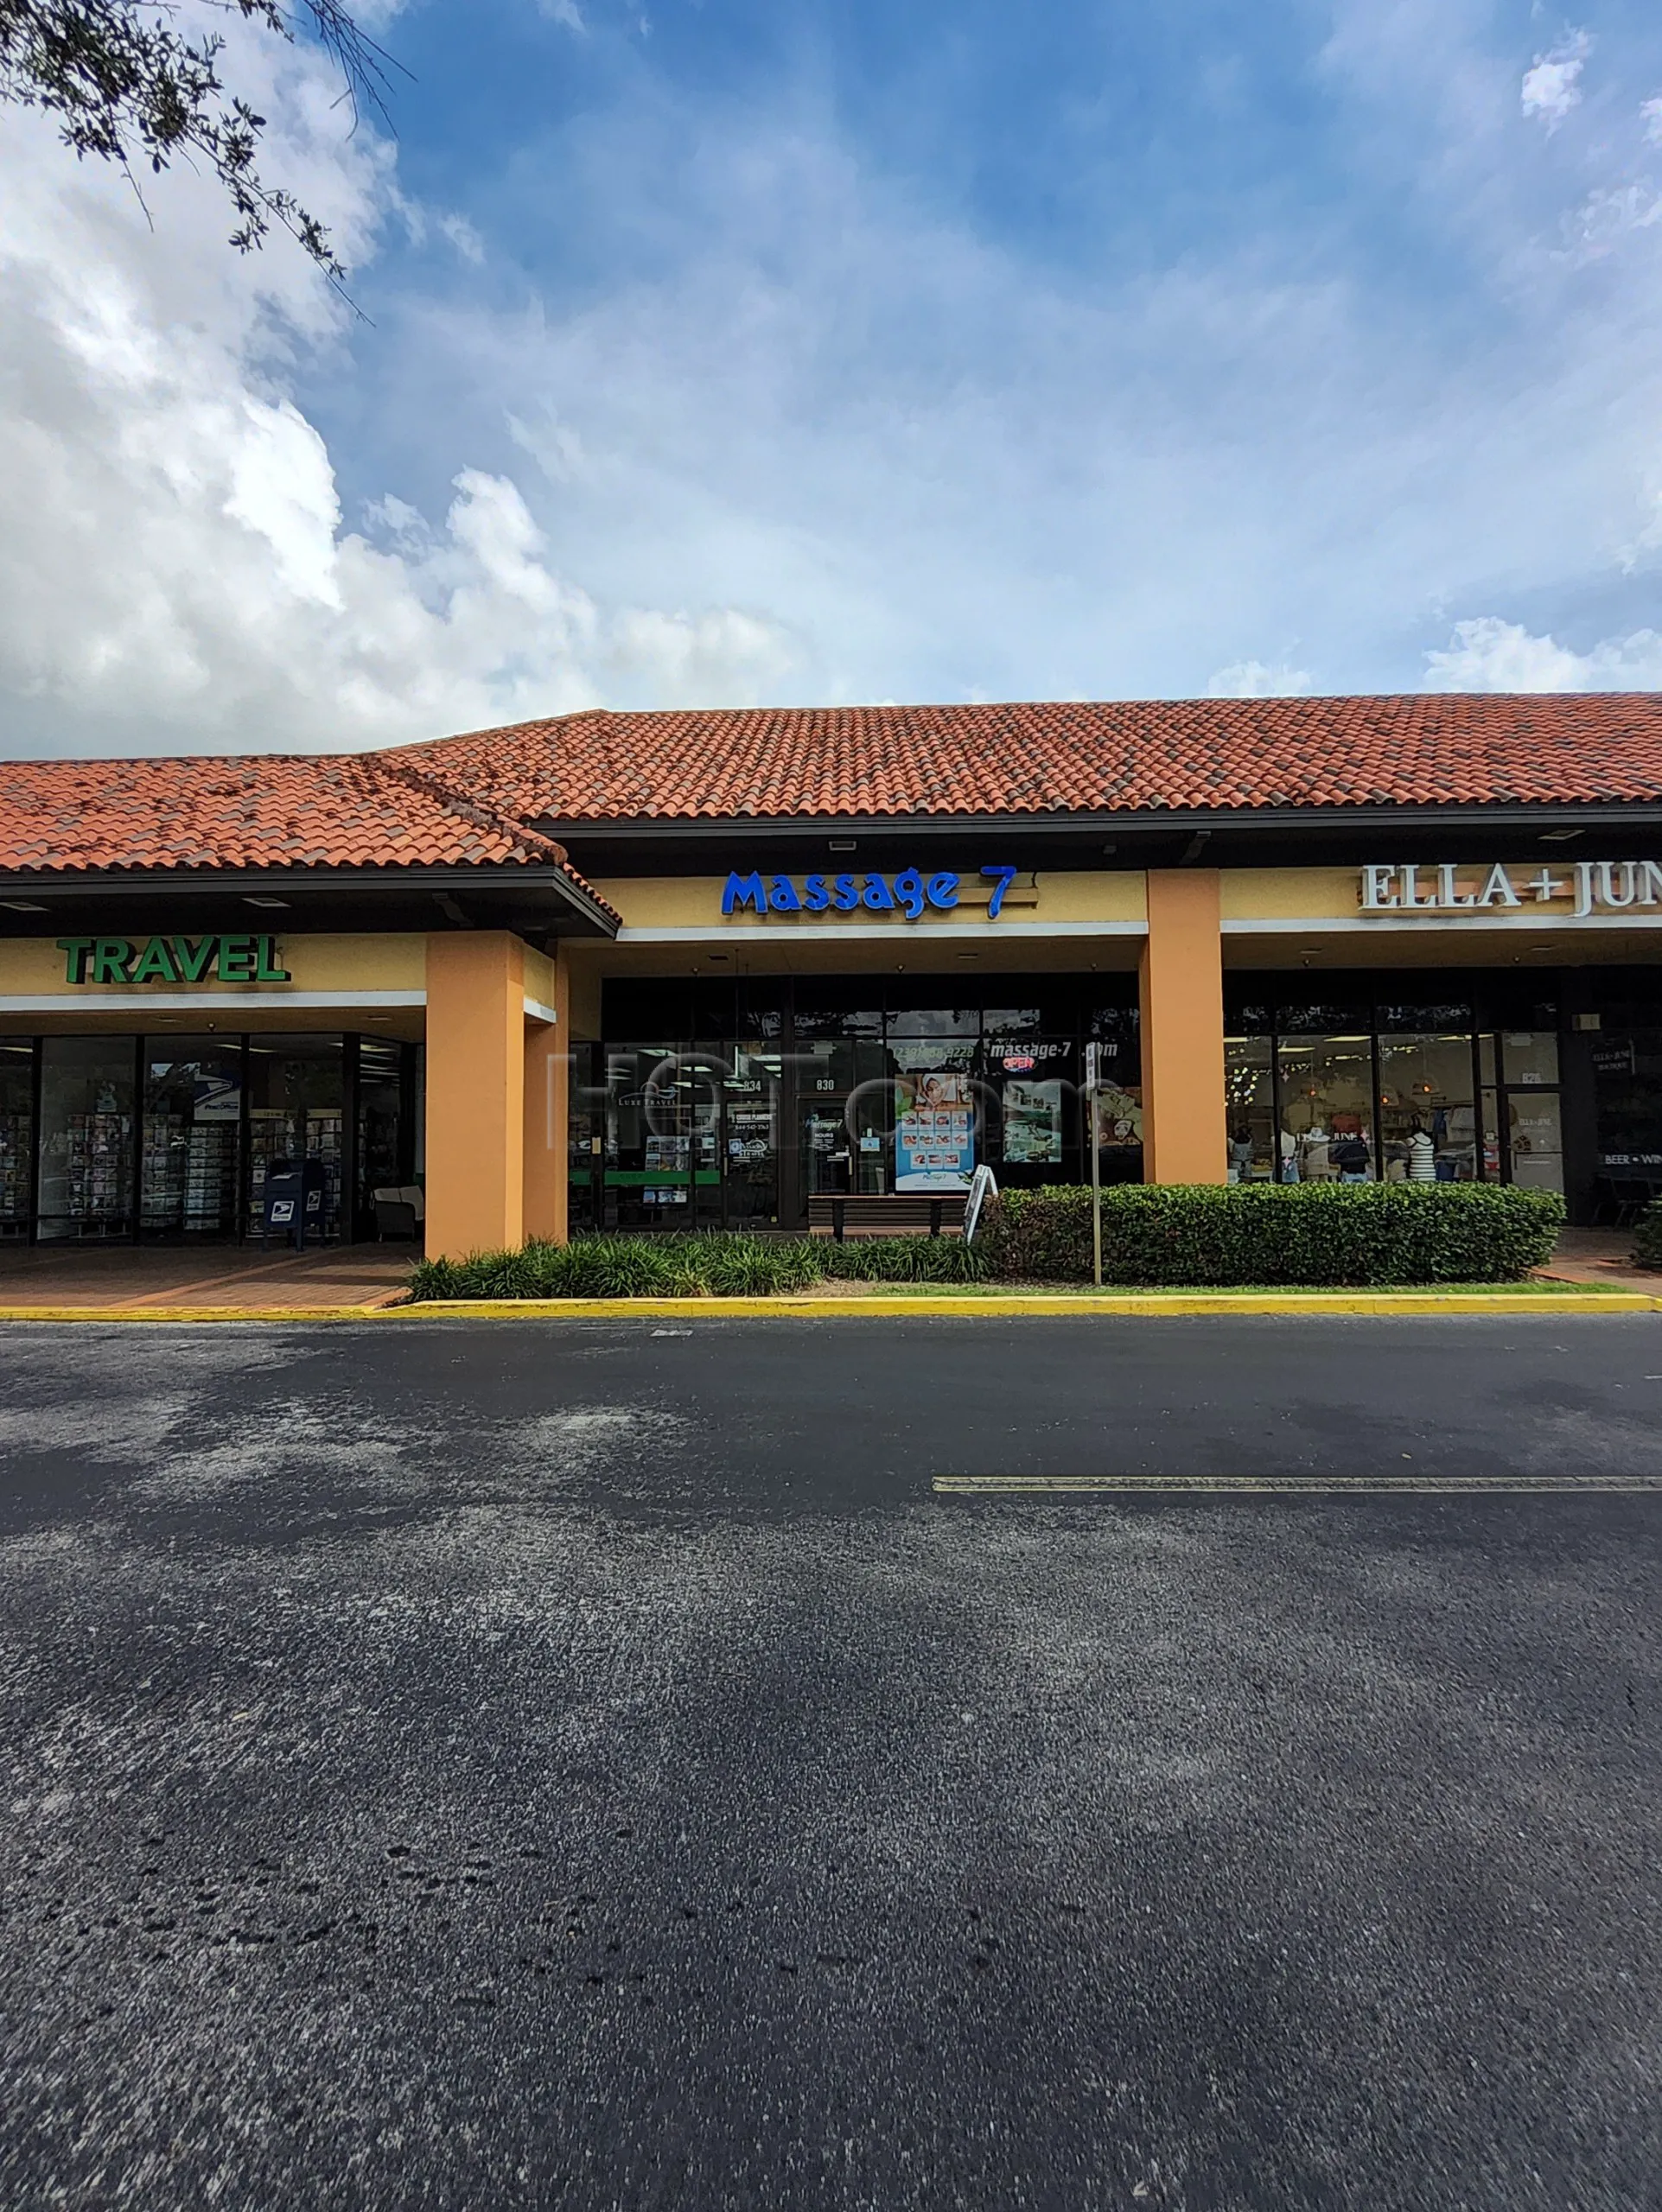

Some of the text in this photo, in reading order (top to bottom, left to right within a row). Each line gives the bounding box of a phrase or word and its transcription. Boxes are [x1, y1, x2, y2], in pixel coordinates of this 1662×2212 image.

[722, 866, 1016, 920] Massage 7
[1359, 863, 1522, 910] ELLA
[56, 936, 290, 983] TRAVEL
[990, 1042, 1071, 1059] massage-7
[1003, 1058, 1035, 1070] OPEN
[743, 1080, 761, 1091] 834
[816, 1079, 835, 1090] 830
[1605, 1154, 1630, 1165] BEER
